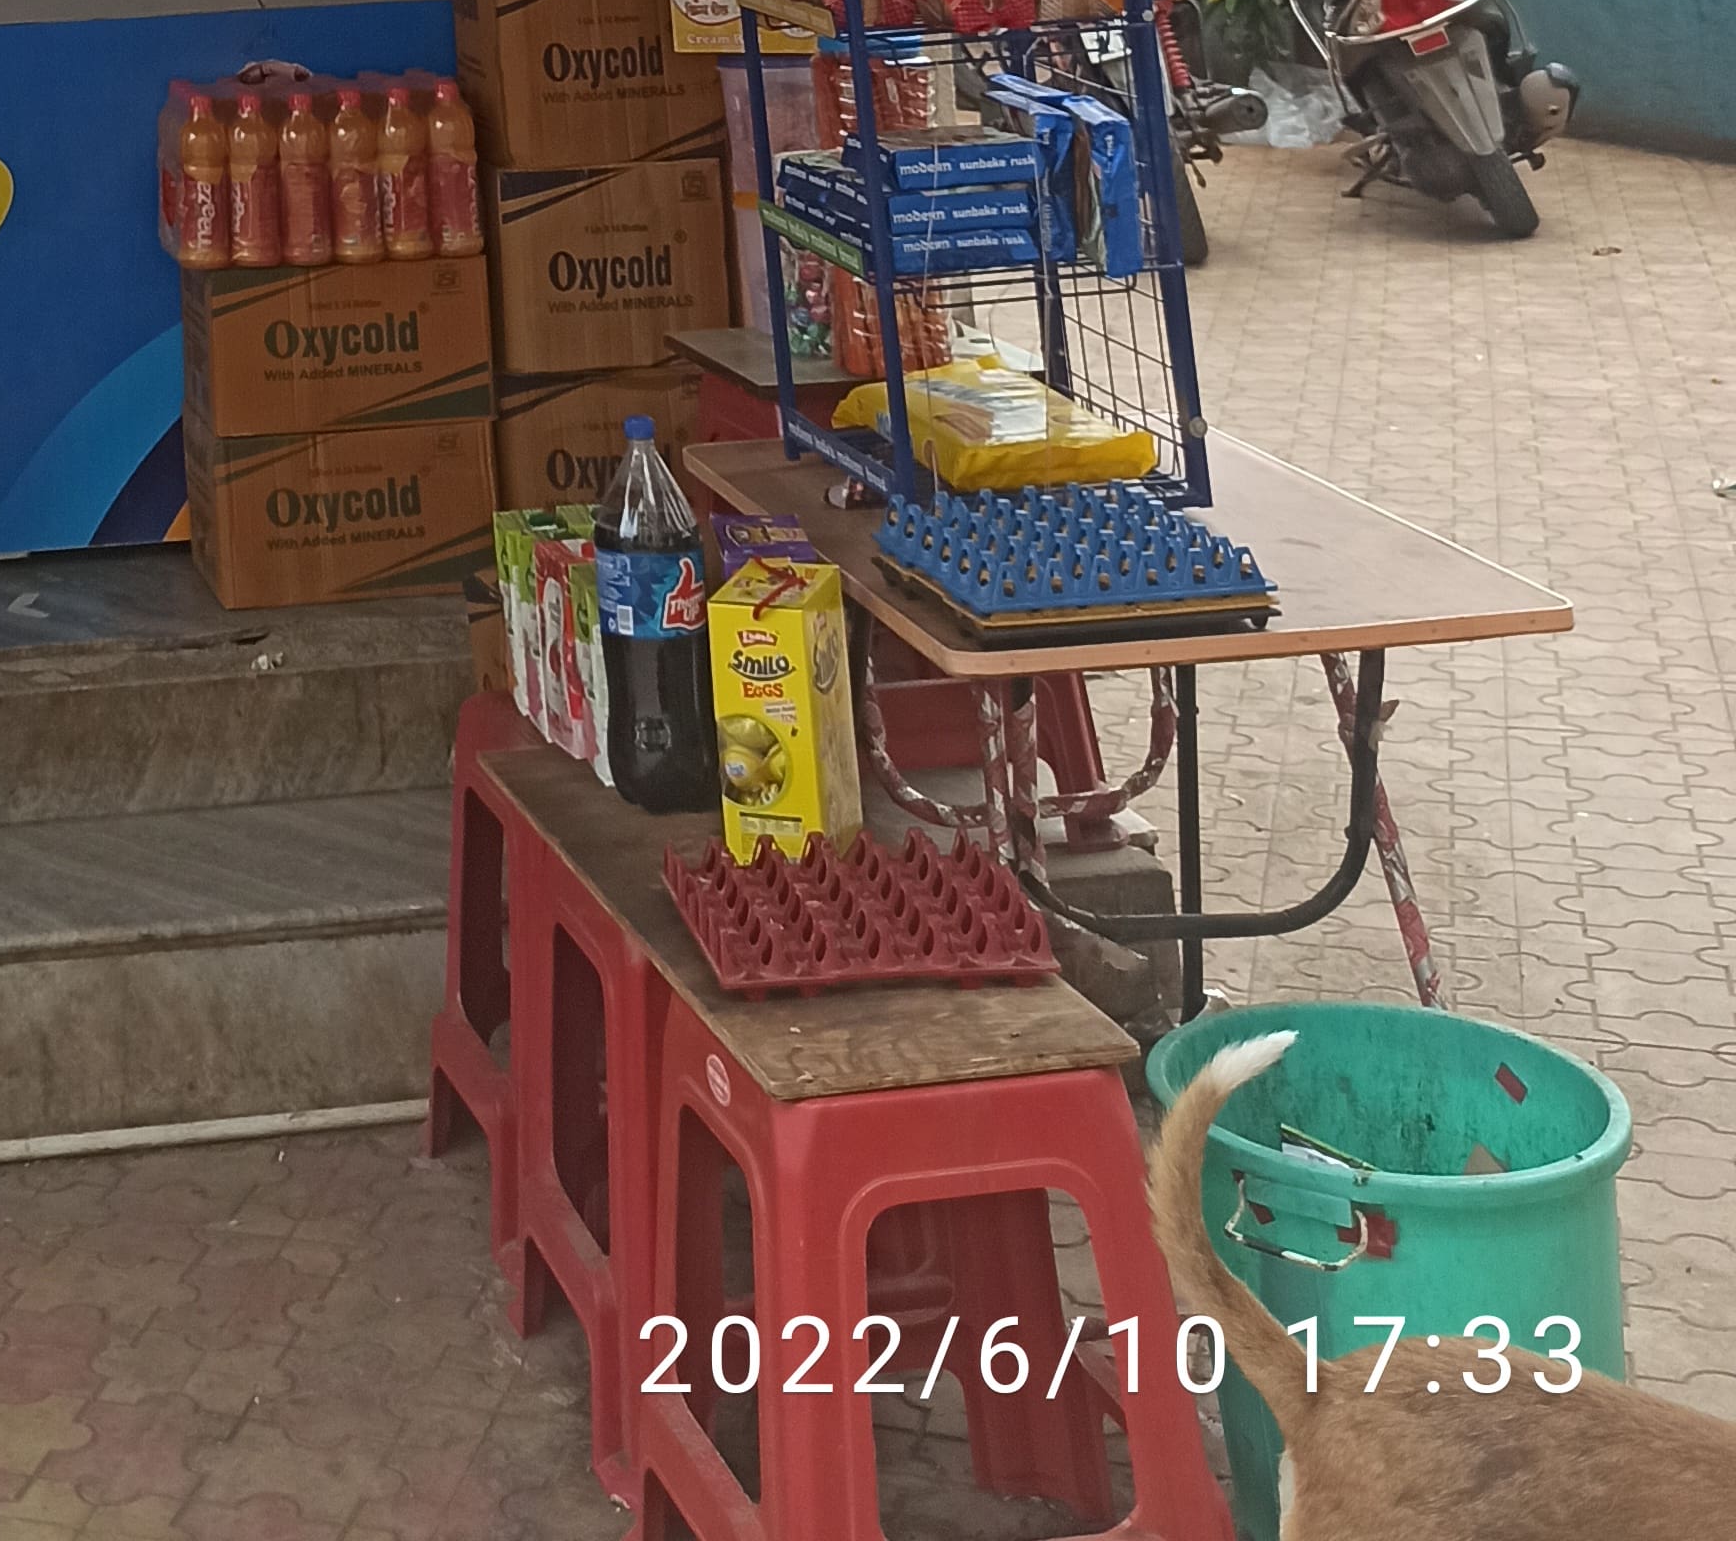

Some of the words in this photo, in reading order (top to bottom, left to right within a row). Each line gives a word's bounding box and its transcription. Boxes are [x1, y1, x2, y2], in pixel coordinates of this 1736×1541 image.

[542, 35, 665, 84] Oxycold
[548, 247, 673, 299] Oxycold
[622, 294, 694, 311] MINERALS
[264, 311, 420, 365] Oxycold
[347, 361, 423, 378] MINERALS
[267, 474, 423, 534] Oxycold
[742, 681, 784, 700] EGGS
